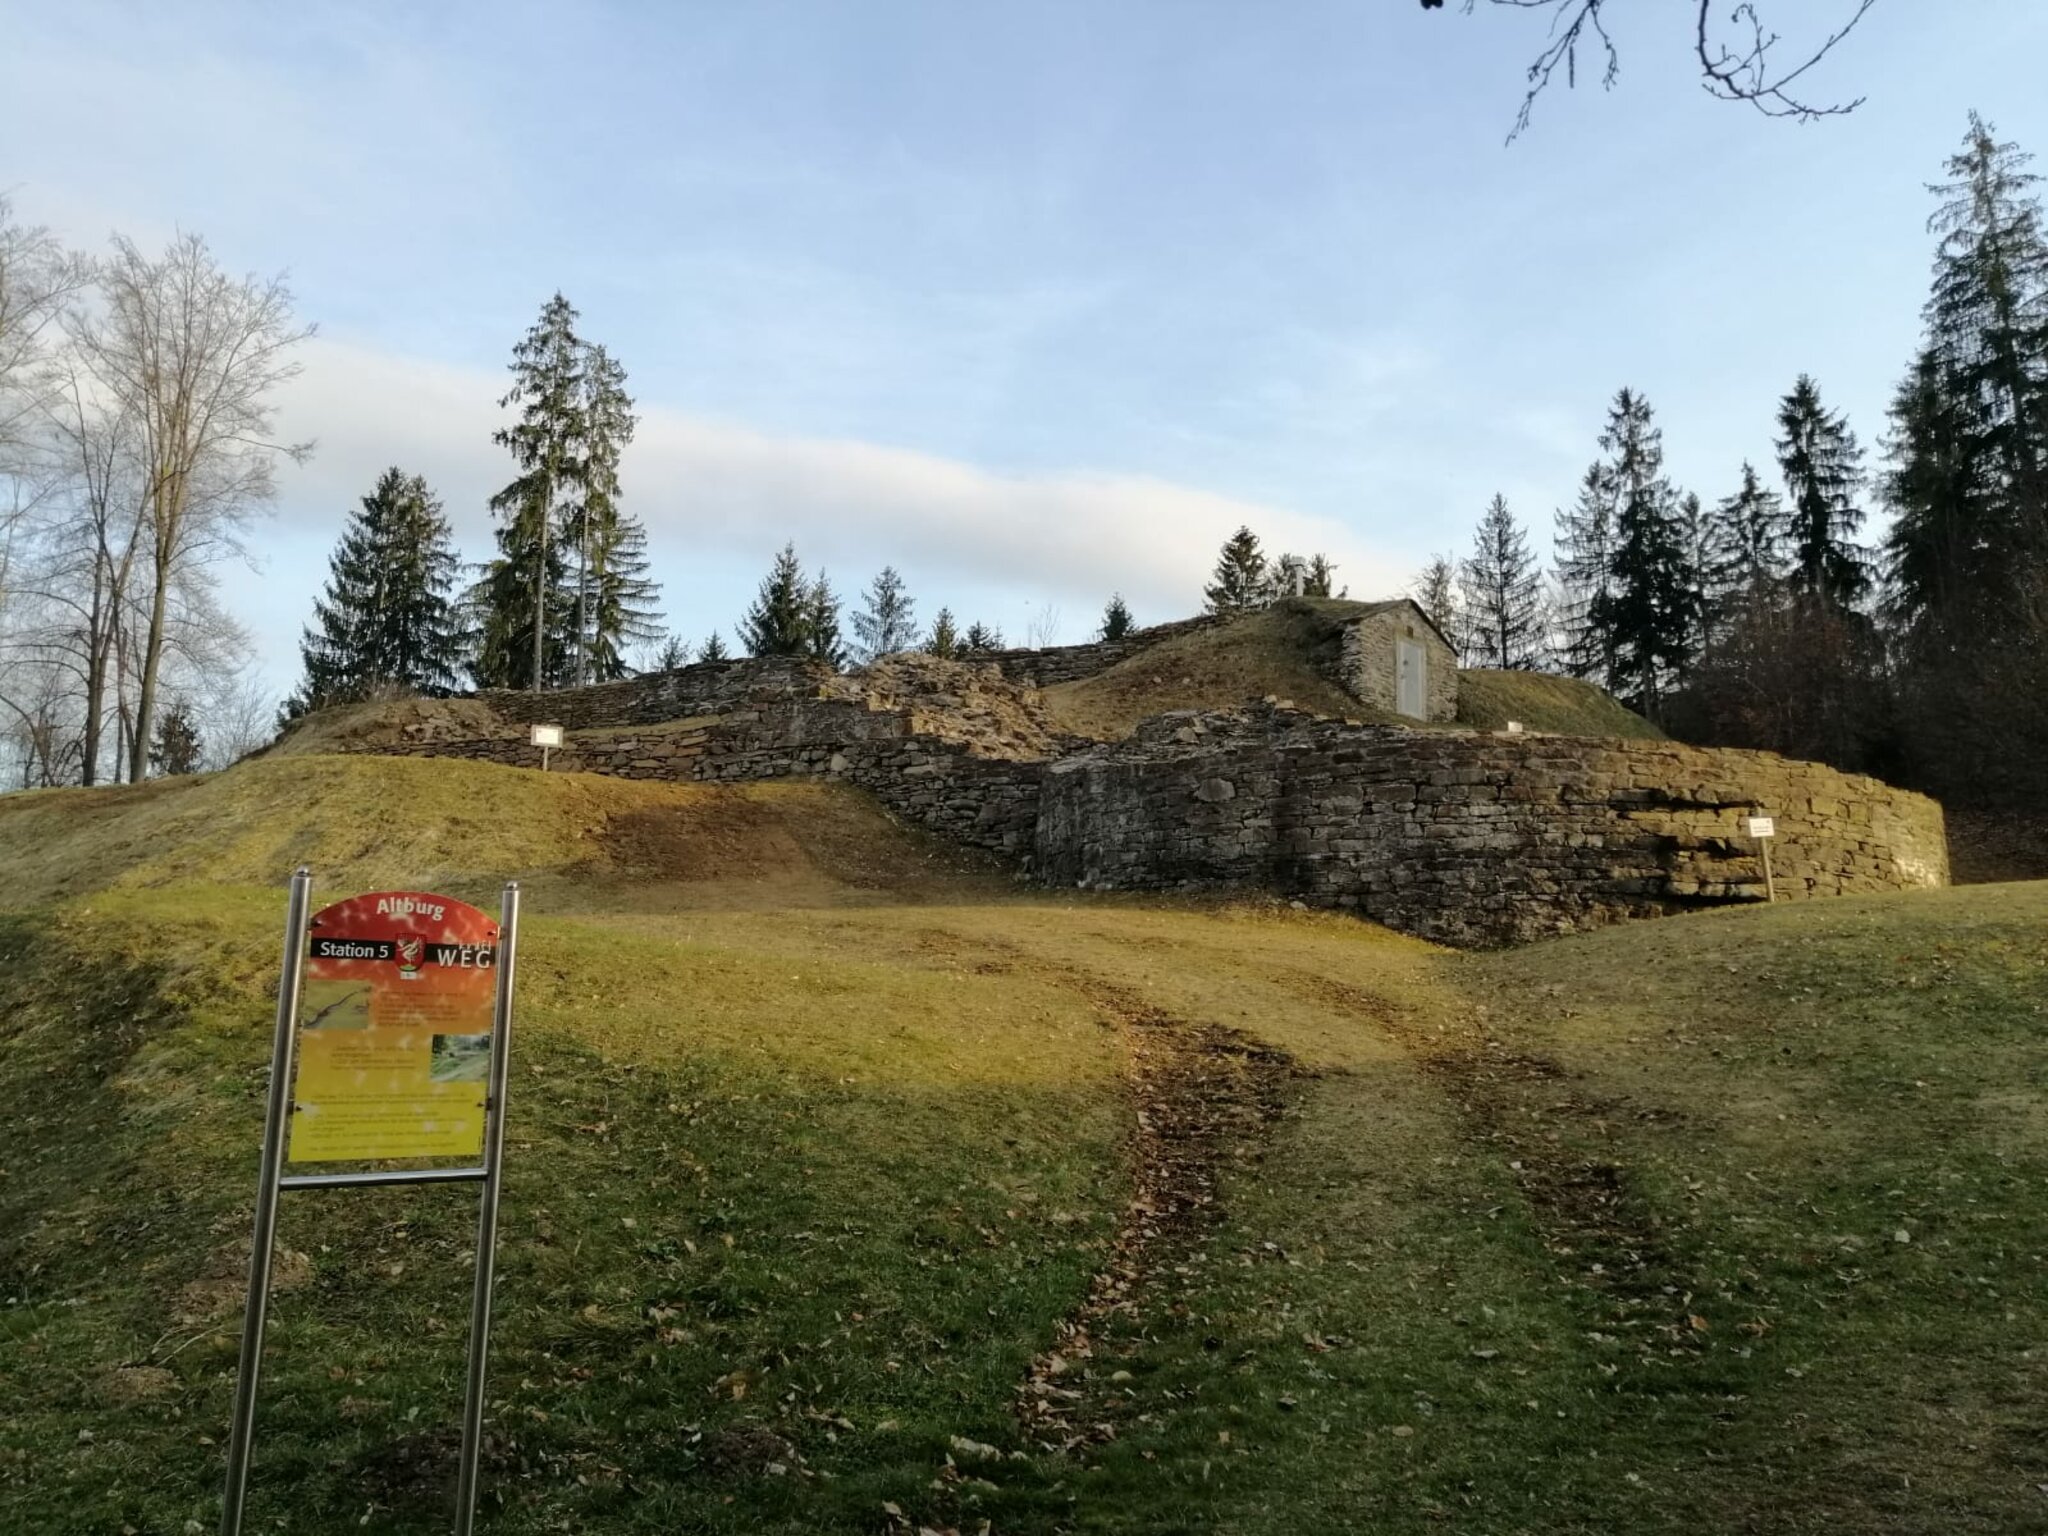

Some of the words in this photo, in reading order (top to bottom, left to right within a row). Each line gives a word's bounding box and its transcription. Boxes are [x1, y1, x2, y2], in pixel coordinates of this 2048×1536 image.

[376, 897, 445, 921] Altburg
[320, 941, 374, 958] Station
[378, 945, 389, 958] 5
[437, 949, 490, 969] WEG
